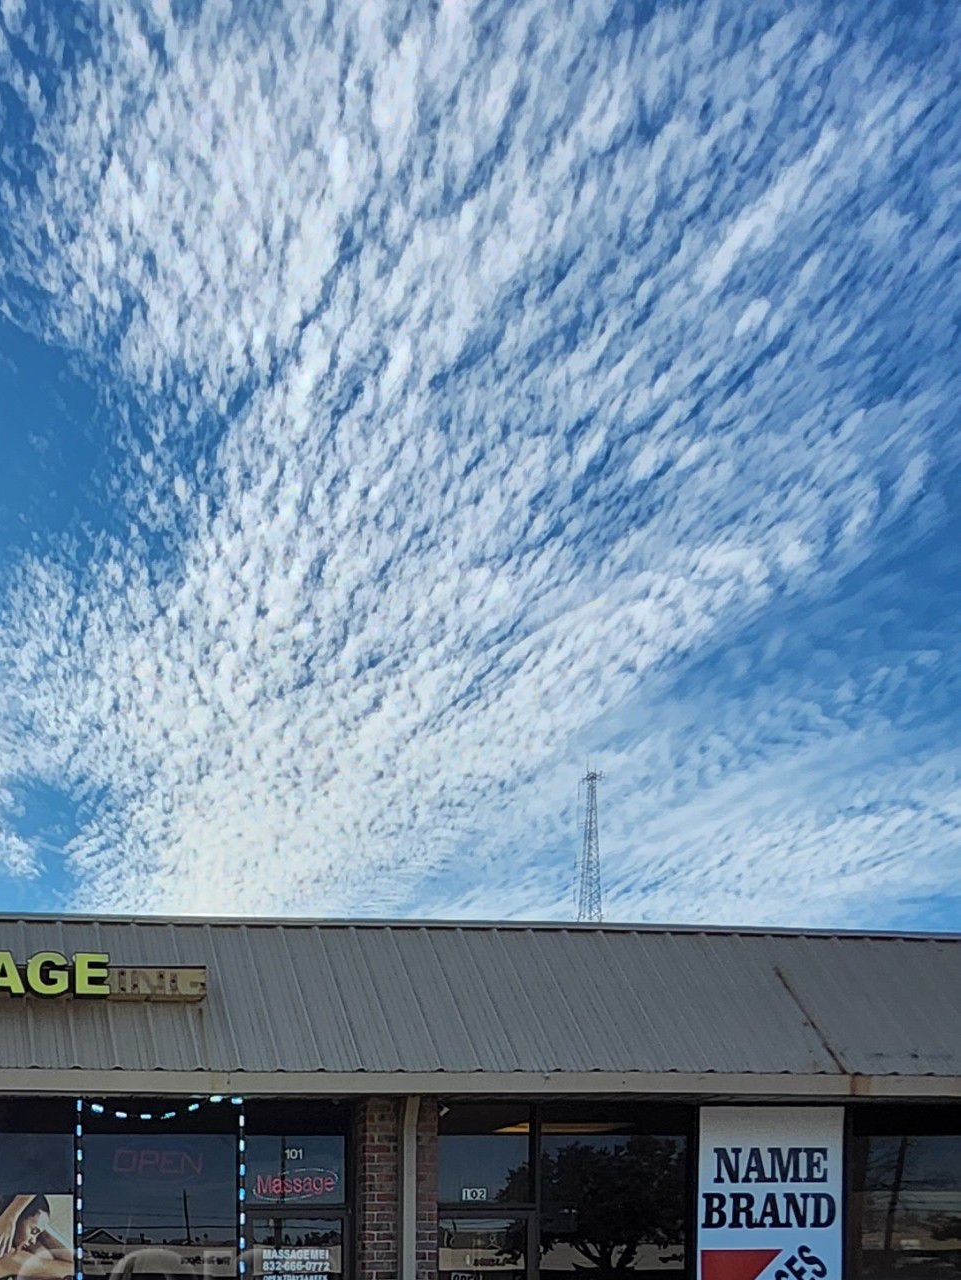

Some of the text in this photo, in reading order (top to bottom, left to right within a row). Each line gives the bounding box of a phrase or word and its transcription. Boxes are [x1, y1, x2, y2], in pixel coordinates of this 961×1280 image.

[112, 1148, 203, 1175] OPEN
[285, 1149, 303, 1160] 101
[713, 1147, 828, 1184] NAME
[257, 1174, 335, 1197] Massage
[464, 1188, 485, 1200] 102
[701, 1193, 836, 1230] BRAND
[262, 1249, 329, 1260] MASSAGE MEI
